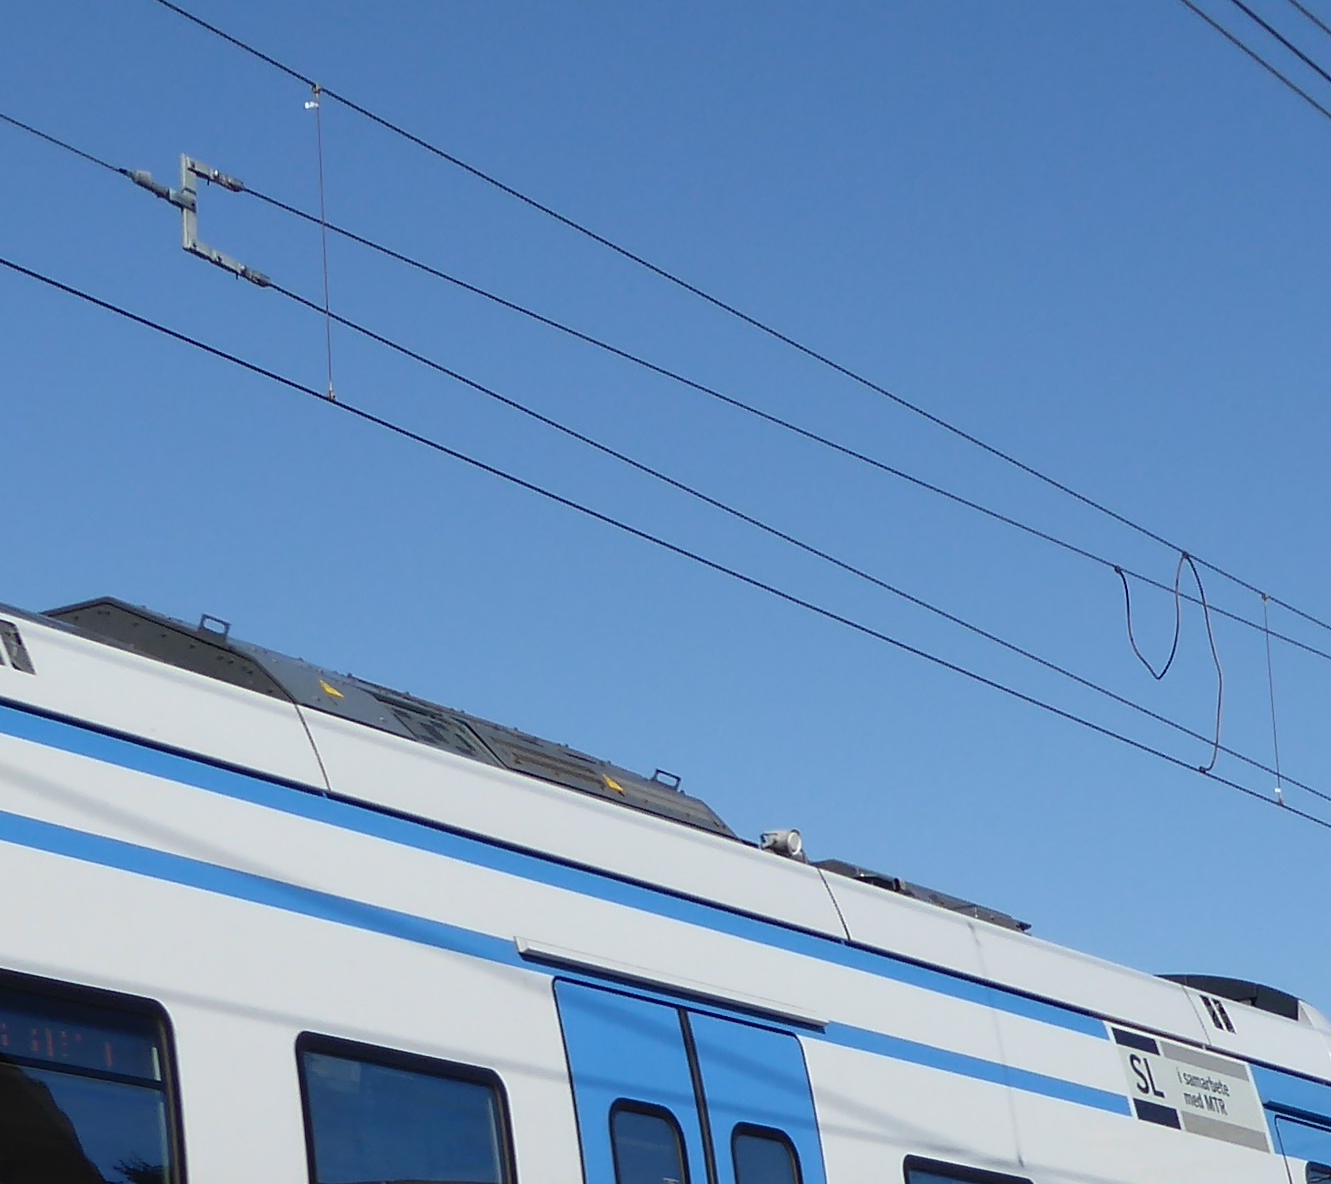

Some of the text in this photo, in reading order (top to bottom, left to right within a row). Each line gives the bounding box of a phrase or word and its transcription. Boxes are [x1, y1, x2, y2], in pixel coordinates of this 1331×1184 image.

[1129, 1053, 1166, 1099] SL
[1182, 1072, 1230, 1097] samarbete
[1183, 1092, 1228, 1116] med MTR
